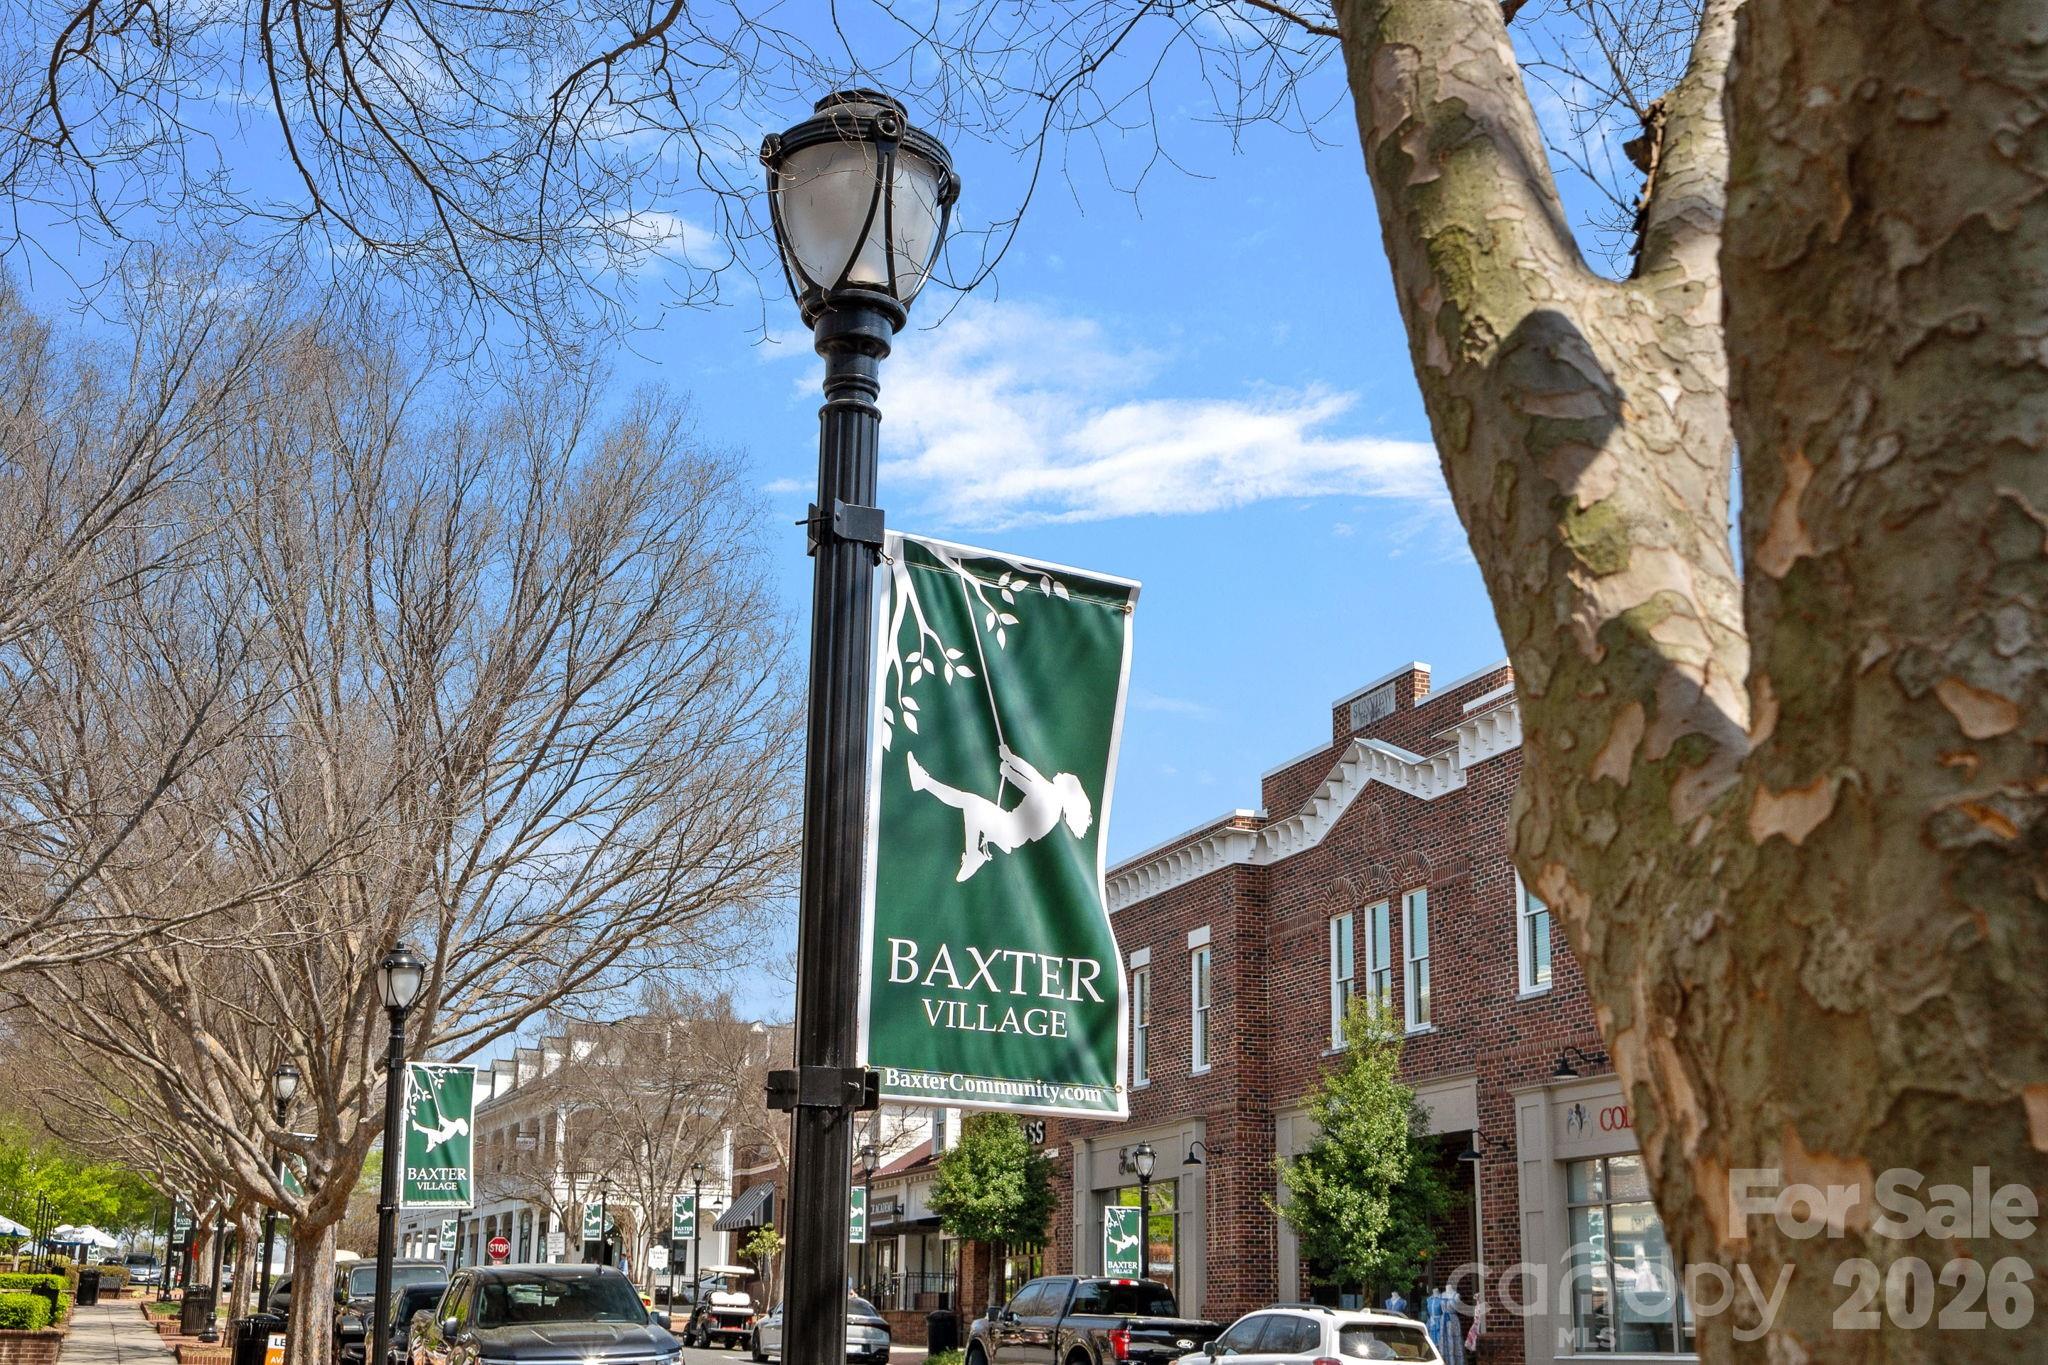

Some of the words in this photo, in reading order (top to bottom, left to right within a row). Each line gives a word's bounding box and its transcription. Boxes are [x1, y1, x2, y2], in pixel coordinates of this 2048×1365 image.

[888, 937, 1104, 1003] BAXTER
[922, 998, 1068, 1038] VILLAGE
[884, 1067, 1102, 1103] BaxterCommunity.com
[407, 1167, 467, 1180] BAXTER
[417, 1181, 458, 1190] VILLAGE
[489, 1243, 508, 1253] STOP
[1108, 1261, 1138, 1269] BAXTER
